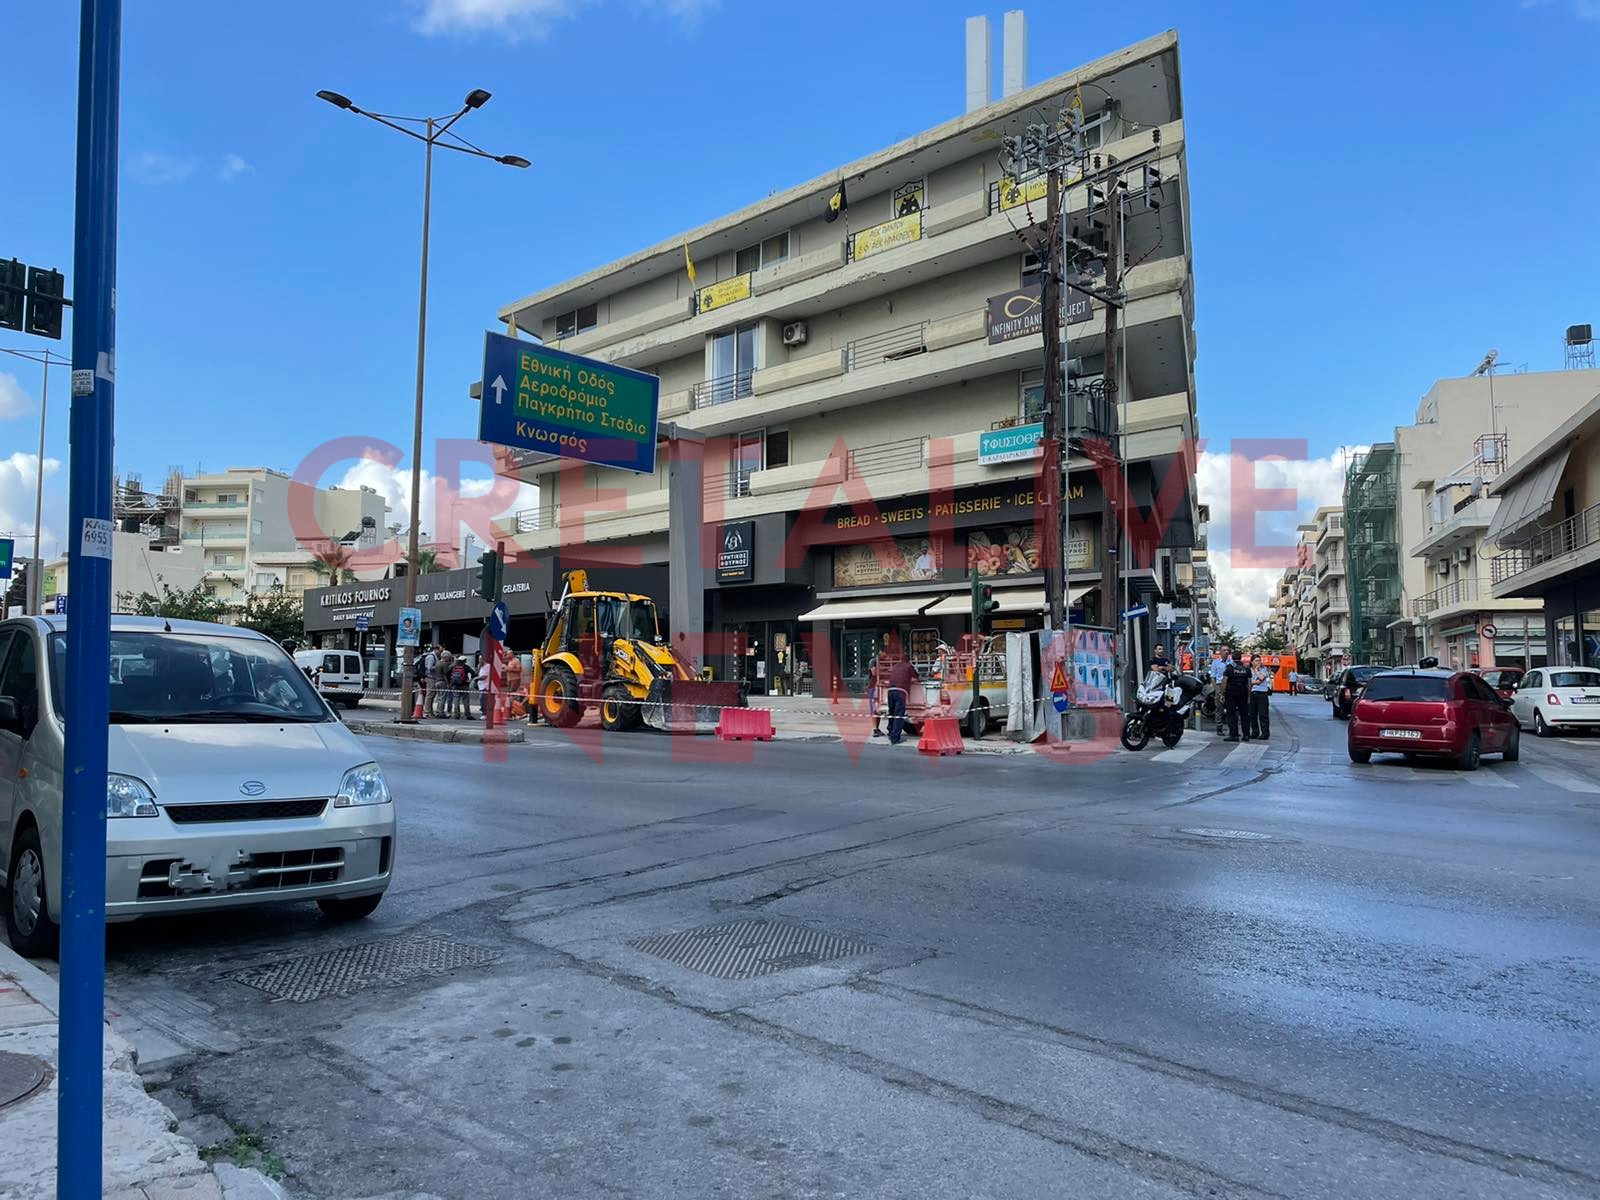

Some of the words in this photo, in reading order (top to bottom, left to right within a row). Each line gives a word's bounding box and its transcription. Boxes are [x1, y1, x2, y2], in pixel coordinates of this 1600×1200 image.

[992, 319, 1022, 336] INFINITY
[521, 354, 571, 382] Εθνική
[578, 370, 615, 396] Οδός
[519, 374, 608, 408] Αεροδρόμιο
[518, 392, 595, 422] Παγκρήτιο
[601, 412, 647, 435] Στάδιο
[516, 421, 588, 453] Κνωσσός
[837, 514, 871, 529] BREAD
[881, 508, 923, 524] SWEETS
[935, 497, 1001, 516] PATISSERIE
[1014, 491, 1034, 506] ICE
[1037, 485, 1084, 503] CAM
[720, 552, 746, 561] ΚΡΗΤΙΚΟΣ
[720, 559, 746, 567] ΦΟΥΡΝΟΣ
[320, 592, 352, 606] KRITIKOS
[355, 587, 390, 603] FOURNOS
[434, 589, 466, 601] BOULANGERIE
[503, 582, 530, 594] GELATERIA
